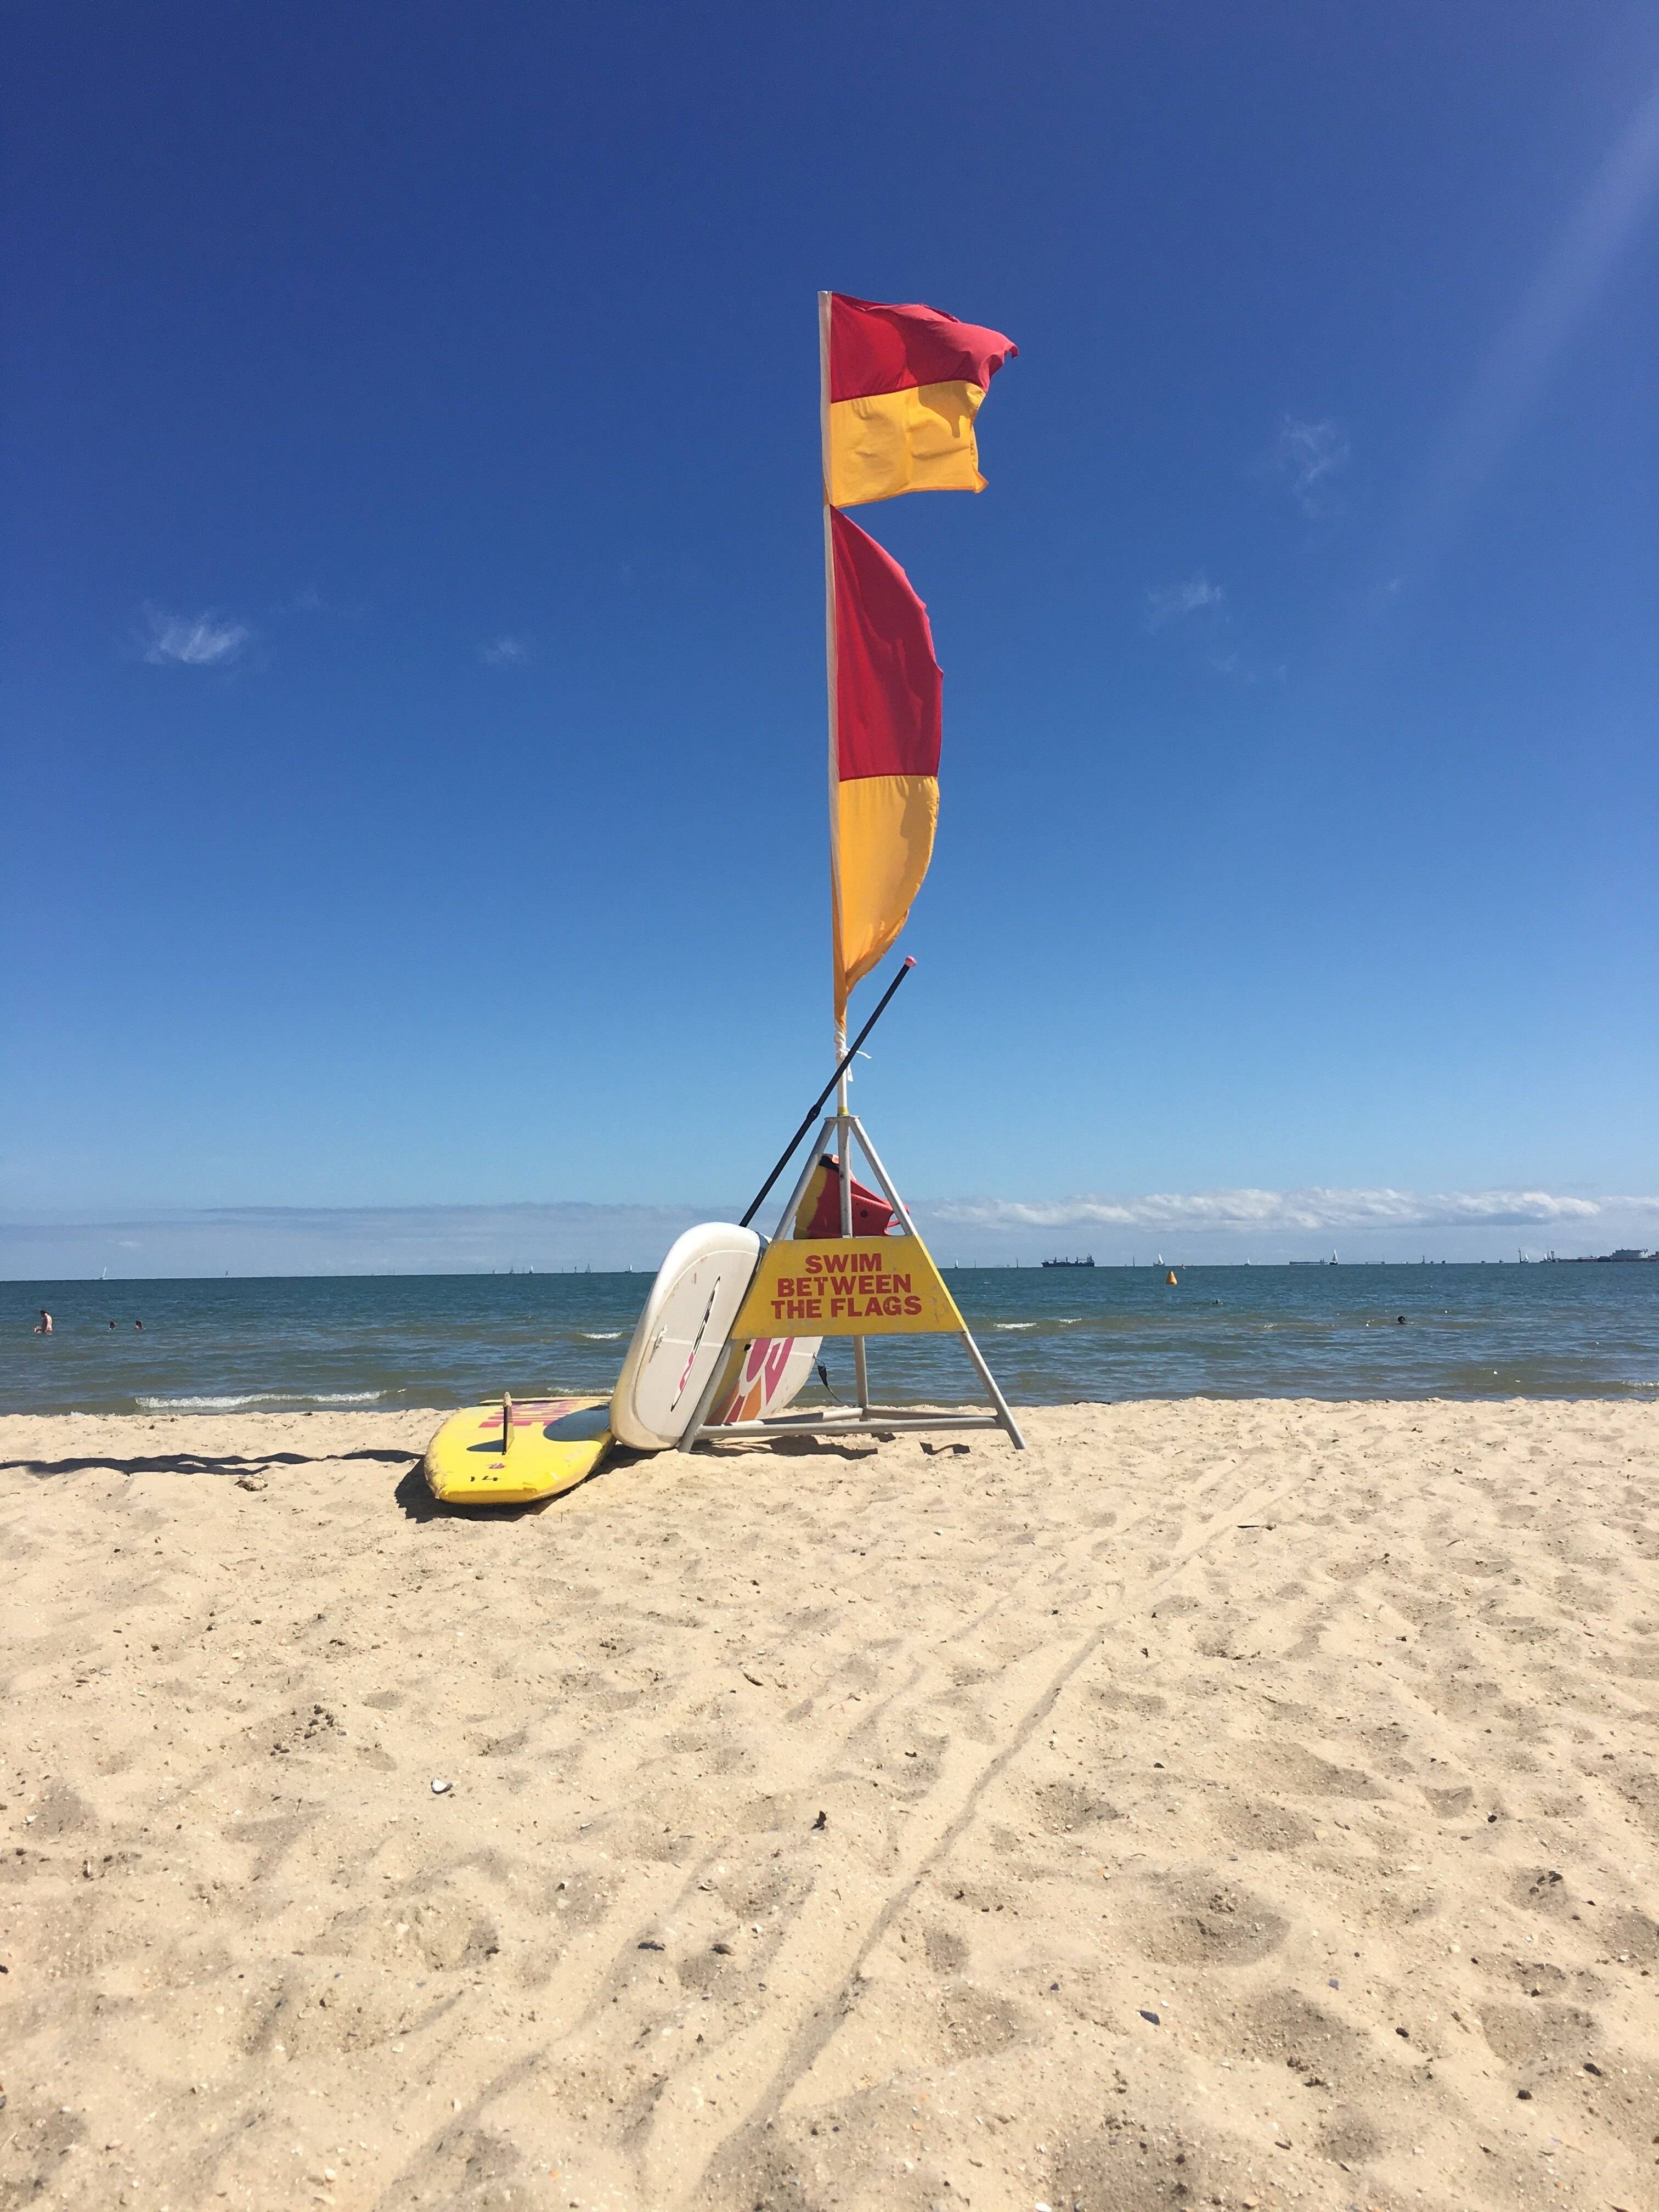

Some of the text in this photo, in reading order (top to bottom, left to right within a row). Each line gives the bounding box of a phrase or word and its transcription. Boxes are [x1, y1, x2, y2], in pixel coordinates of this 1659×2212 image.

[805, 1254, 882, 1273] SWIM
[777, 1274, 911, 1297] BETWEEN
[771, 1296, 922, 1319] THE FLAGS
